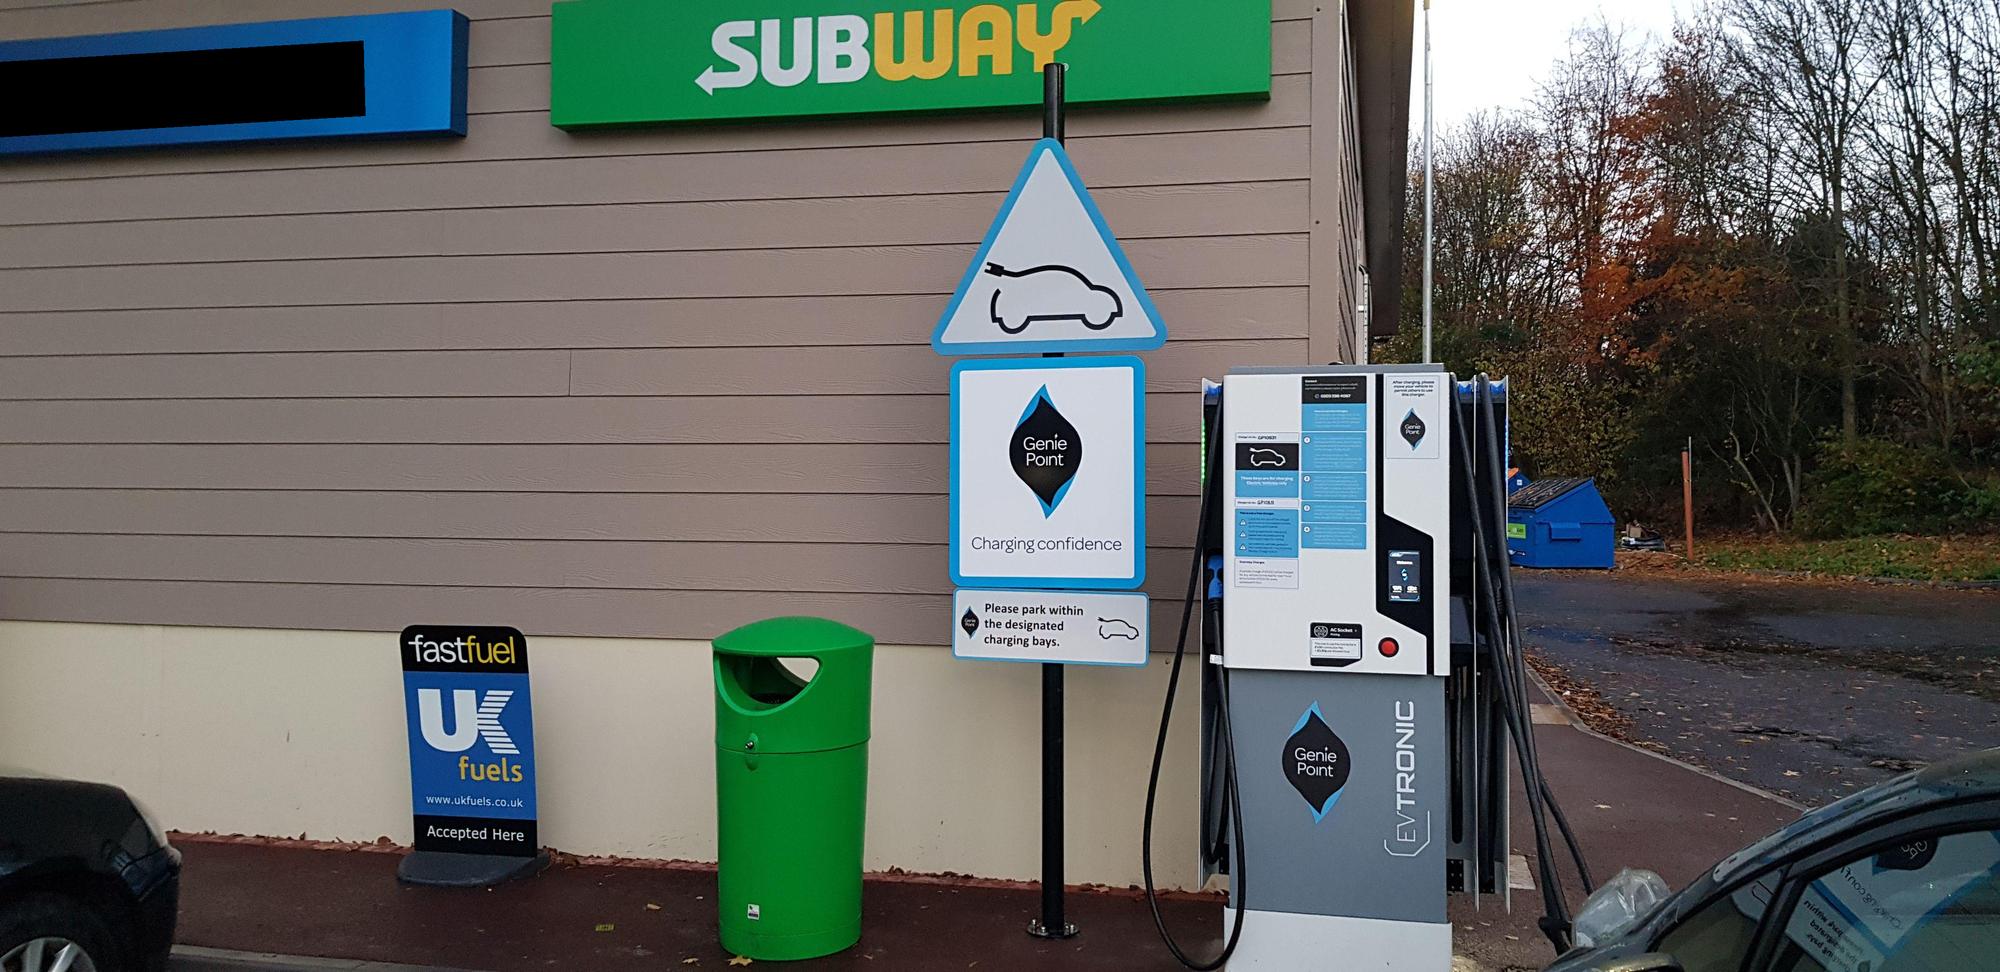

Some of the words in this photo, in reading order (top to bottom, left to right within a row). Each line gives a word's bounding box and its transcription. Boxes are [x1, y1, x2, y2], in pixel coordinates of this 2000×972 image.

[694, 0, 1102, 96] SUBWAY
[1023, 432, 1067, 452] Genie
[1026, 452, 1065, 467] Point
[970, 535, 1035, 554] Charging
[1037, 535, 1122, 552] confidence
[984, 603, 1020, 615] Please
[1022, 604, 1047, 618] park
[1049, 605, 1084, 617] within
[984, 619, 1002, 630] the
[1004, 619, 1064, 635] designated
[408, 635, 516, 664] fastfuel
[984, 634, 1029, 650] charging
[1031, 635, 1061, 650] bays.
[418, 688, 520, 755] UK
[1294, 746, 1337, 763] Genie
[459, 756, 523, 782] fuels
[1297, 762, 1334, 777] Point
[1395, 700, 1416, 842] EVTRONIC
[426, 794, 523, 809] www.ukfuels.co.uk
[427, 825, 487, 842] Accepted
[492, 828, 525, 842] Here
